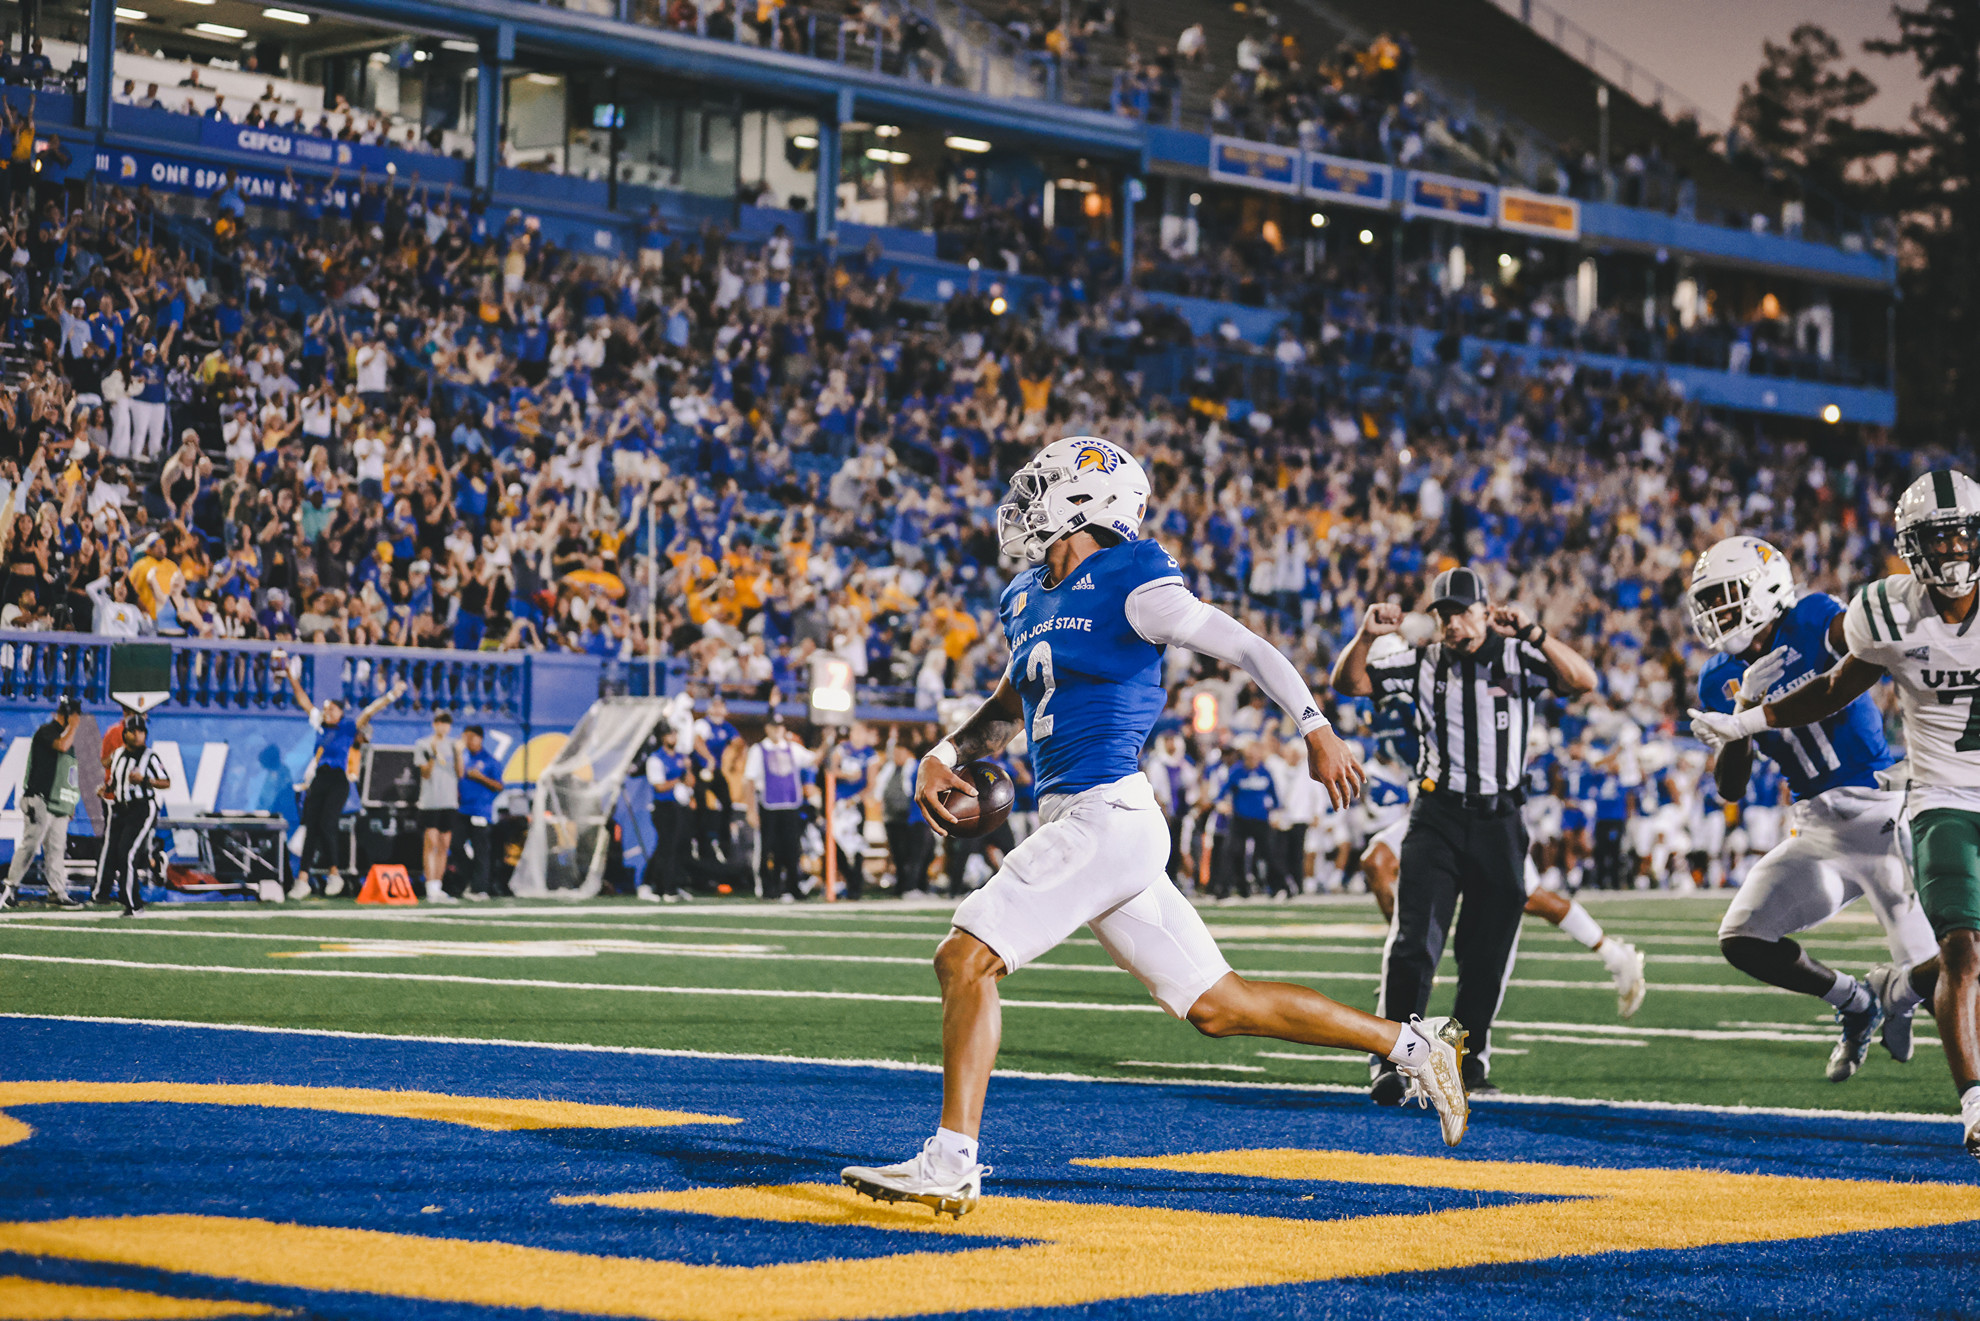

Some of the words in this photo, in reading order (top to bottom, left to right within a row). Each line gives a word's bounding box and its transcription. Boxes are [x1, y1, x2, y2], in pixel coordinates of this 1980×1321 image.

[151, 161, 190, 185] ONE
[194, 168, 276, 197] SPATAN
[1112, 520, 1130, 535] SAN
[1028, 614, 1055, 639] JOSÉ
[1055, 616, 1093, 632] STATE
[1026, 640, 1056, 742] 2
[1496, 711, 1510, 731] B
[381, 871, 410, 899] 20
